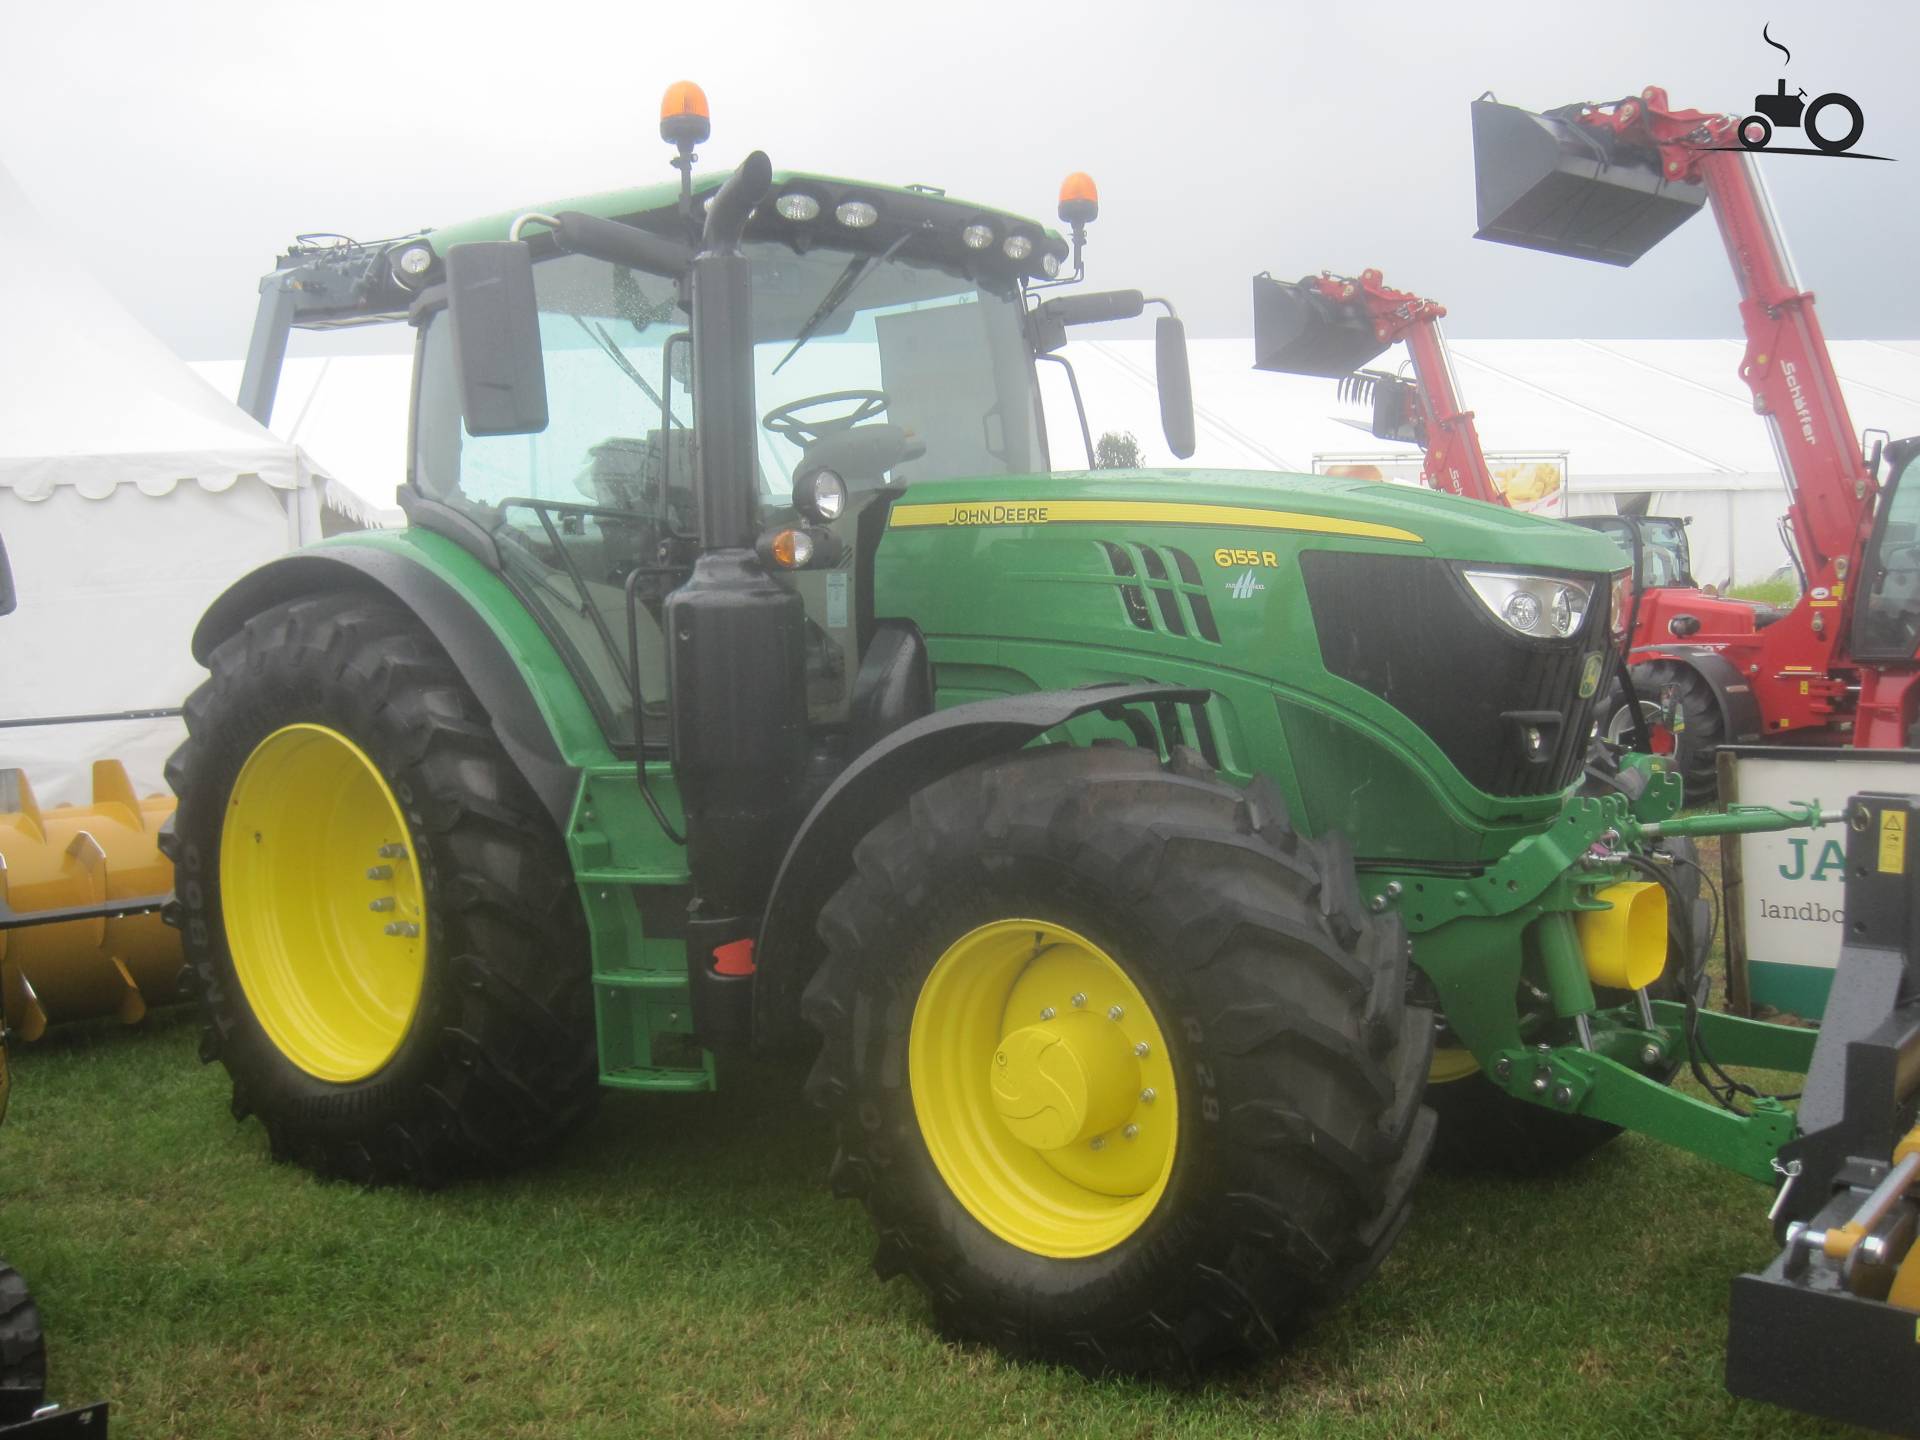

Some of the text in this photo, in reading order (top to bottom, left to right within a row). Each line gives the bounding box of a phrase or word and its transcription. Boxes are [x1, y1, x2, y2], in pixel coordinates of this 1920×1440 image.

[1780, 360, 1816, 445] Schäffer
[948, 505, 1049, 523] JOHN DEERE
